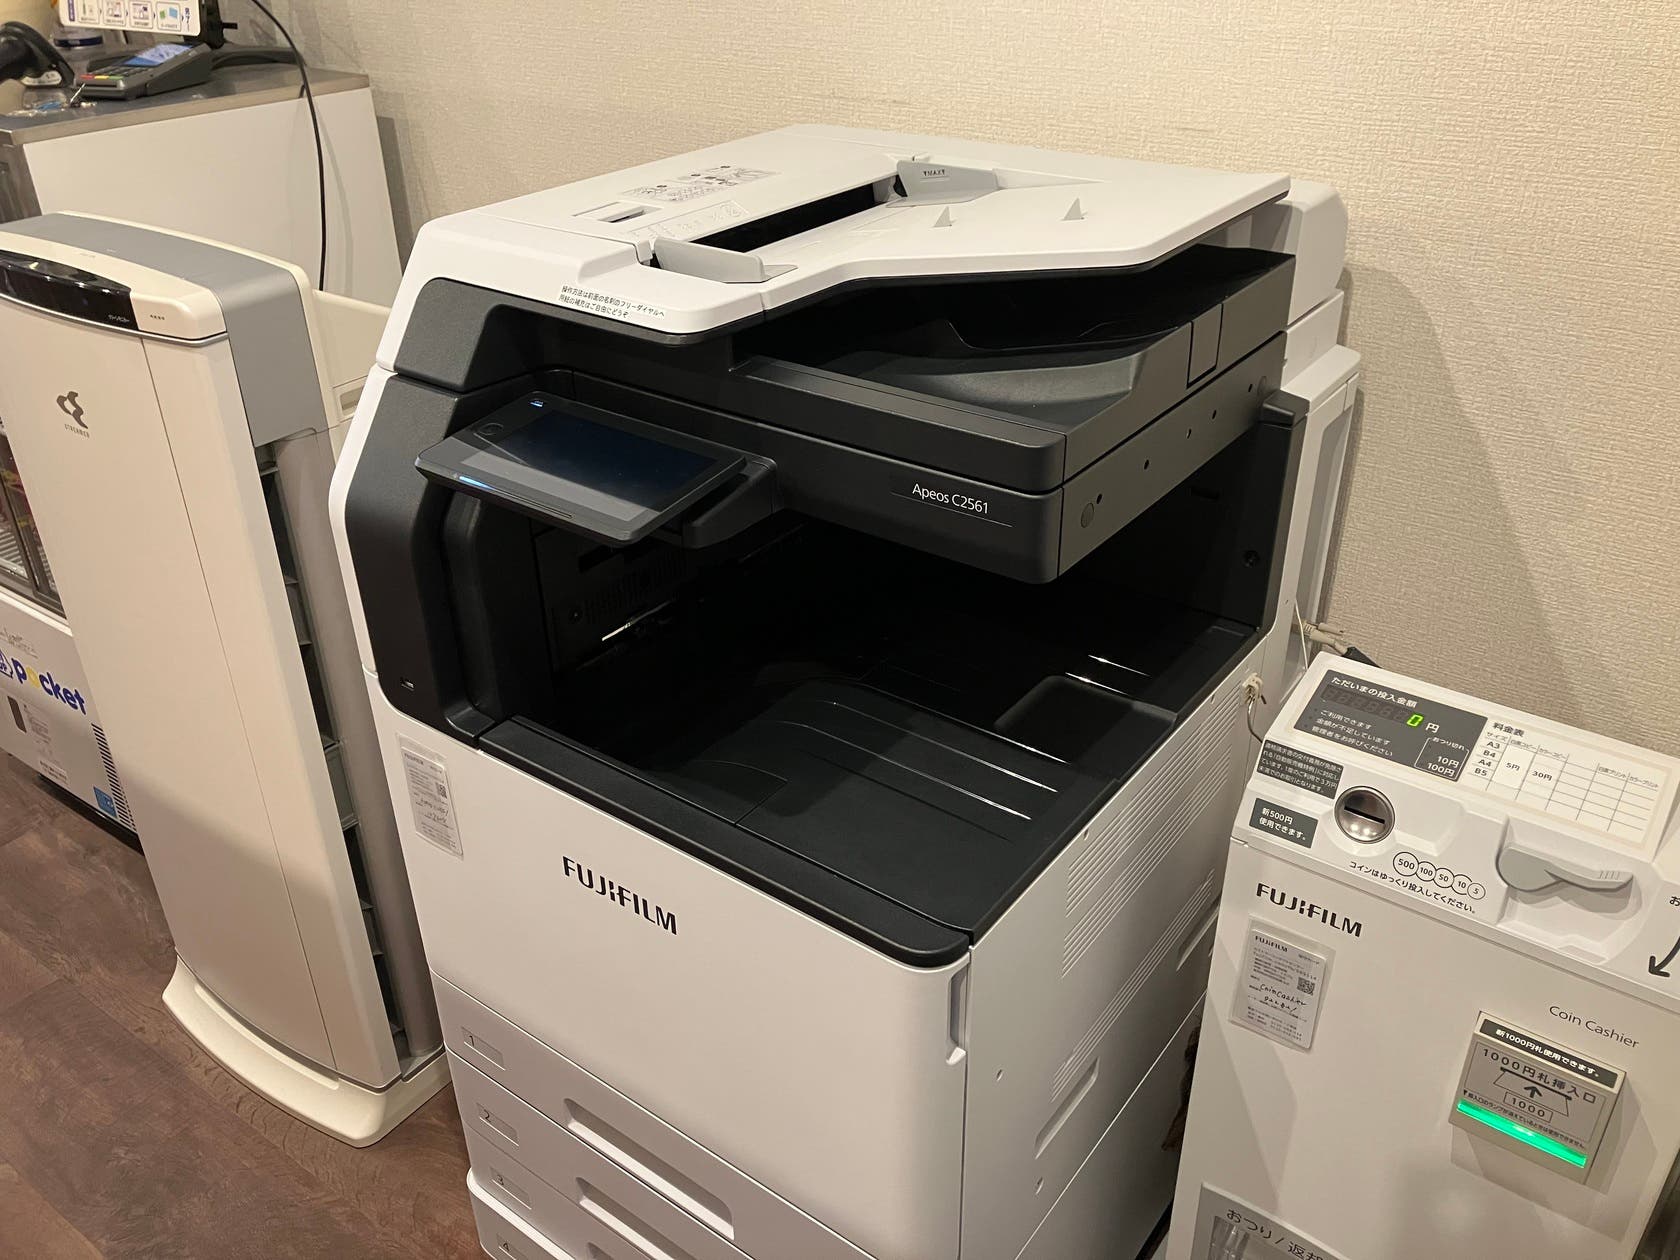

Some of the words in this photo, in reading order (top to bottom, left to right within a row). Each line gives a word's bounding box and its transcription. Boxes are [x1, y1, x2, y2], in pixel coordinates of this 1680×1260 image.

[912, 483, 949, 503] Apeos
[952, 494, 988, 514] C2561
[11, 657, 87, 715] pocket
[1331, 677, 1418, 709] ただいまの投入金額
[1320, 710, 1372, 730] ご利用できます
[1406, 713, 1425, 728] 0
[1425, 722, 1440, 733] 円
[1493, 722, 1525, 737] 料金表
[1311, 726, 1393, 757] 管理者をお呼びください
[1316, 718, 1391, 746] 金額が不足しています
[1432, 737, 1465, 751] おつり切れ
[1483, 750, 1496, 758] B4
[1487, 741, 1501, 749] A3
[1426, 762, 1456, 777] 100円
[1437, 756, 1460, 769] 10円
[1474, 767, 1488, 776] B5
[1478, 759, 1492, 767] A4
[1506, 762, 1520, 771] 5円
[1531, 770, 1553, 781] 30円
[1262, 807, 1293, 825] 新500円
[1259, 817, 1306, 841] 使用できます。
[1398, 858, 1415, 870] 500
[1420, 866, 1433, 876] 100
[1439, 873, 1448, 882] 50
[1457, 881, 1467, 889] 10
[1473, 887, 1479, 895] 5
[563, 856, 677, 935] FUJIFILM
[1349, 861, 1475, 913] コインはゆっくり投入してください。
[1256, 882, 1363, 937] FUJIFILM
[1549, 1005, 1582, 1026] Coin
[1585, 1020, 1639, 1049] Cashier
[468, 1035, 475, 1047] 1
[1496, 1028, 1600, 1078] 新1000円札使用できます。
[1482, 1048, 1597, 1104] 1000円札挿入口
[483, 1109, 492, 1123] 2
[1511, 1097, 1546, 1117] 1000
